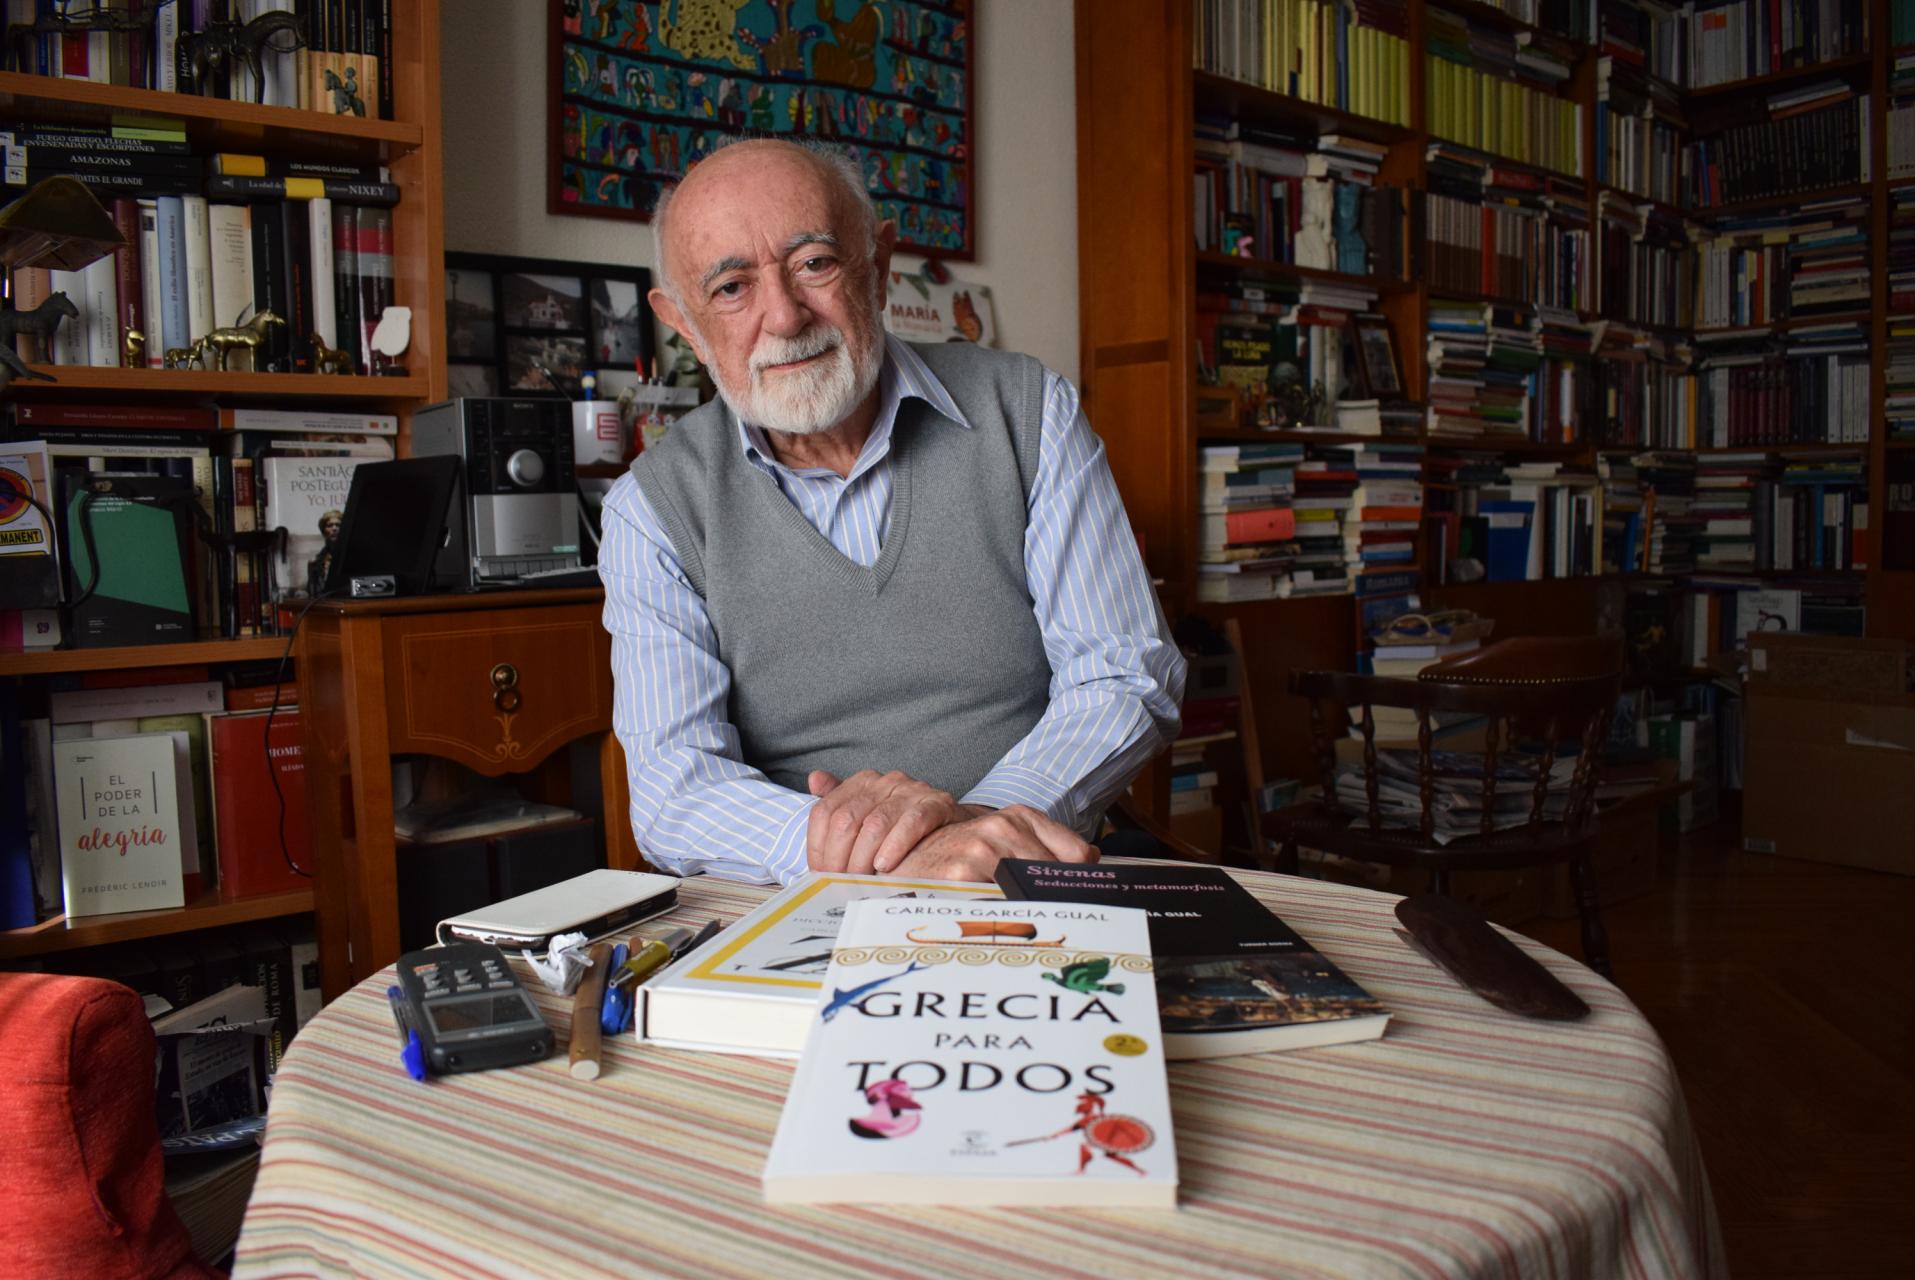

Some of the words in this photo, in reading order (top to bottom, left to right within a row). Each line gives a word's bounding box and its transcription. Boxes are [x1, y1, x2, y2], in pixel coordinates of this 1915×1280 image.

[70, 154, 132, 167] AMAZONAS
[112, 175, 144, 187] GRANDE
[348, 184, 385, 197] NIXEY
[891, 303, 941, 322] MARÍA
[298, 464, 353, 480] SANTIAG
[291, 480, 350, 496] POSTEGU
[0, 532, 40, 545] MANENT
[268, 745, 304, 759] HOME
[109, 775, 125, 786] EL
[95, 789, 142, 802] PODER
[99, 806, 116, 817] DE
[123, 804, 140, 815] LA
[78, 825, 167, 856] alegría
[1026, 865, 1116, 880] Sirenas
[82, 882, 128, 894] FRÉDÉRIC
[132, 879, 167, 890] LENOIR
[1034, 879, 1118, 890] Seducciones
[1121, 883, 1129, 892] y
[1133, 883, 1225, 892] metamorfosis
[885, 905, 963, 919] CARLOS
[970, 906, 1047, 920] GARCÍA
[1055, 909, 1110, 923] GUAL
[270, 961, 281, 997] ROMA
[858, 991, 1123, 1024] GRECIA
[934, 1032, 1034, 1051] PARA
[847, 1061, 1117, 1096] TODOS
